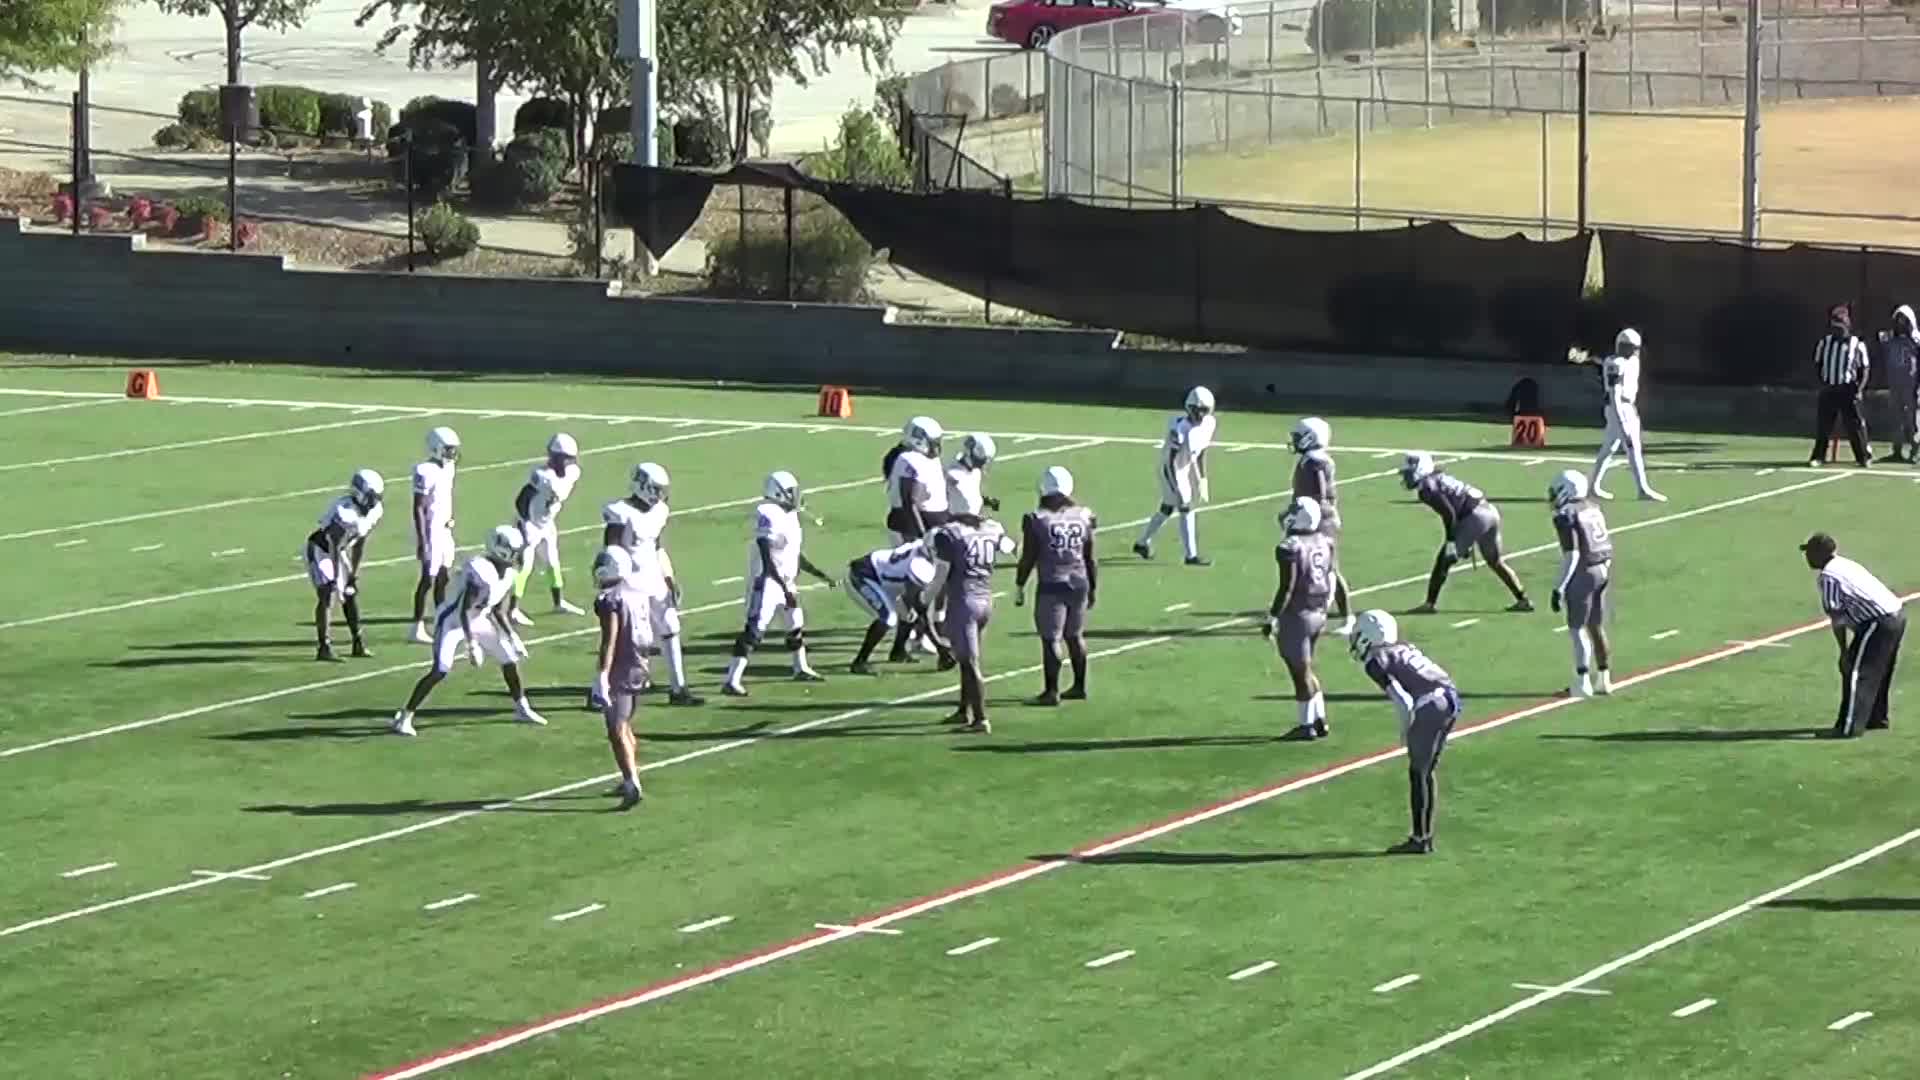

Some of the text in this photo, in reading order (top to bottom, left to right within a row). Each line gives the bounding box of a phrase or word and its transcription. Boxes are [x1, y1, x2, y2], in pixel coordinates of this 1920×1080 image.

[132, 372, 145, 394] G
[822, 390, 842, 416] 10
[1514, 419, 1538, 444] 20
[965, 536, 995, 568] 40
